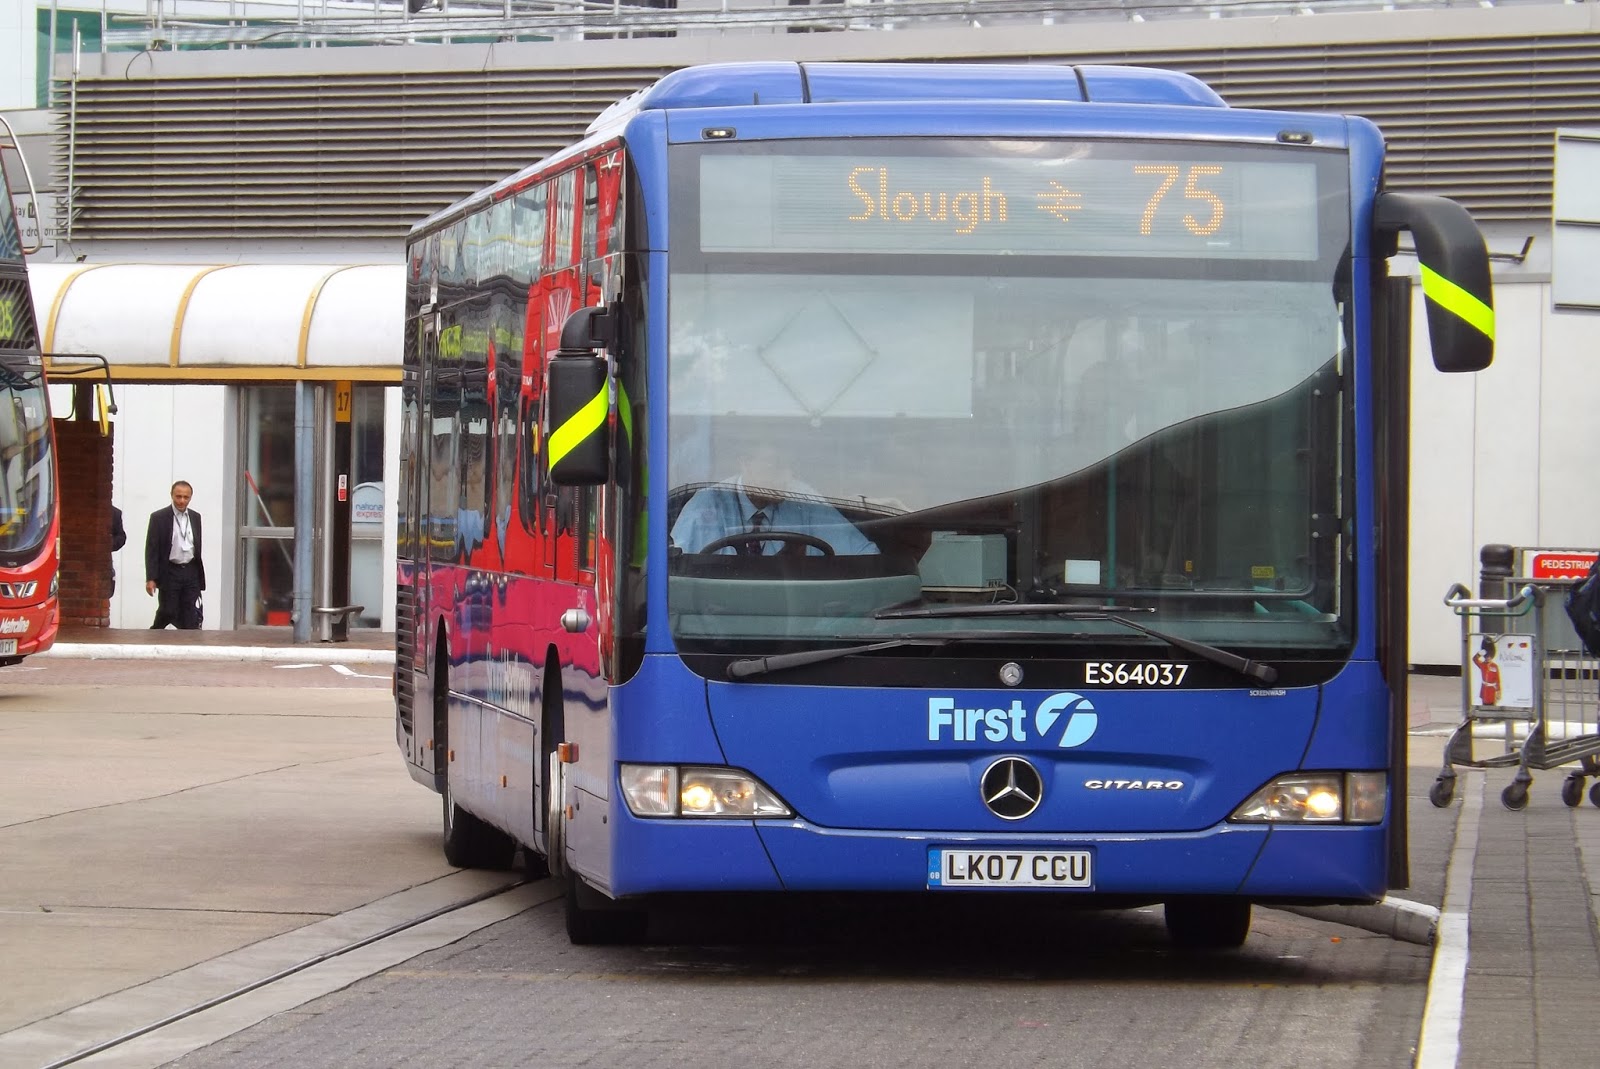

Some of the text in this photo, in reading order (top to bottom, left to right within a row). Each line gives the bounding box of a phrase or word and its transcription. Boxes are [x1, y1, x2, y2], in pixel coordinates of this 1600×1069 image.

[848, 165, 1225, 236] Slough 75
[337, 392, 349, 412] 17
[1085, 662, 1188, 686] ES64037
[1249, 689, 1287, 697] SCREENWASH
[928, 697, 1027, 743] First
[1084, 779, 1185, 791] CITARO
[929, 854, 1087, 881] GB LK07 CCU
